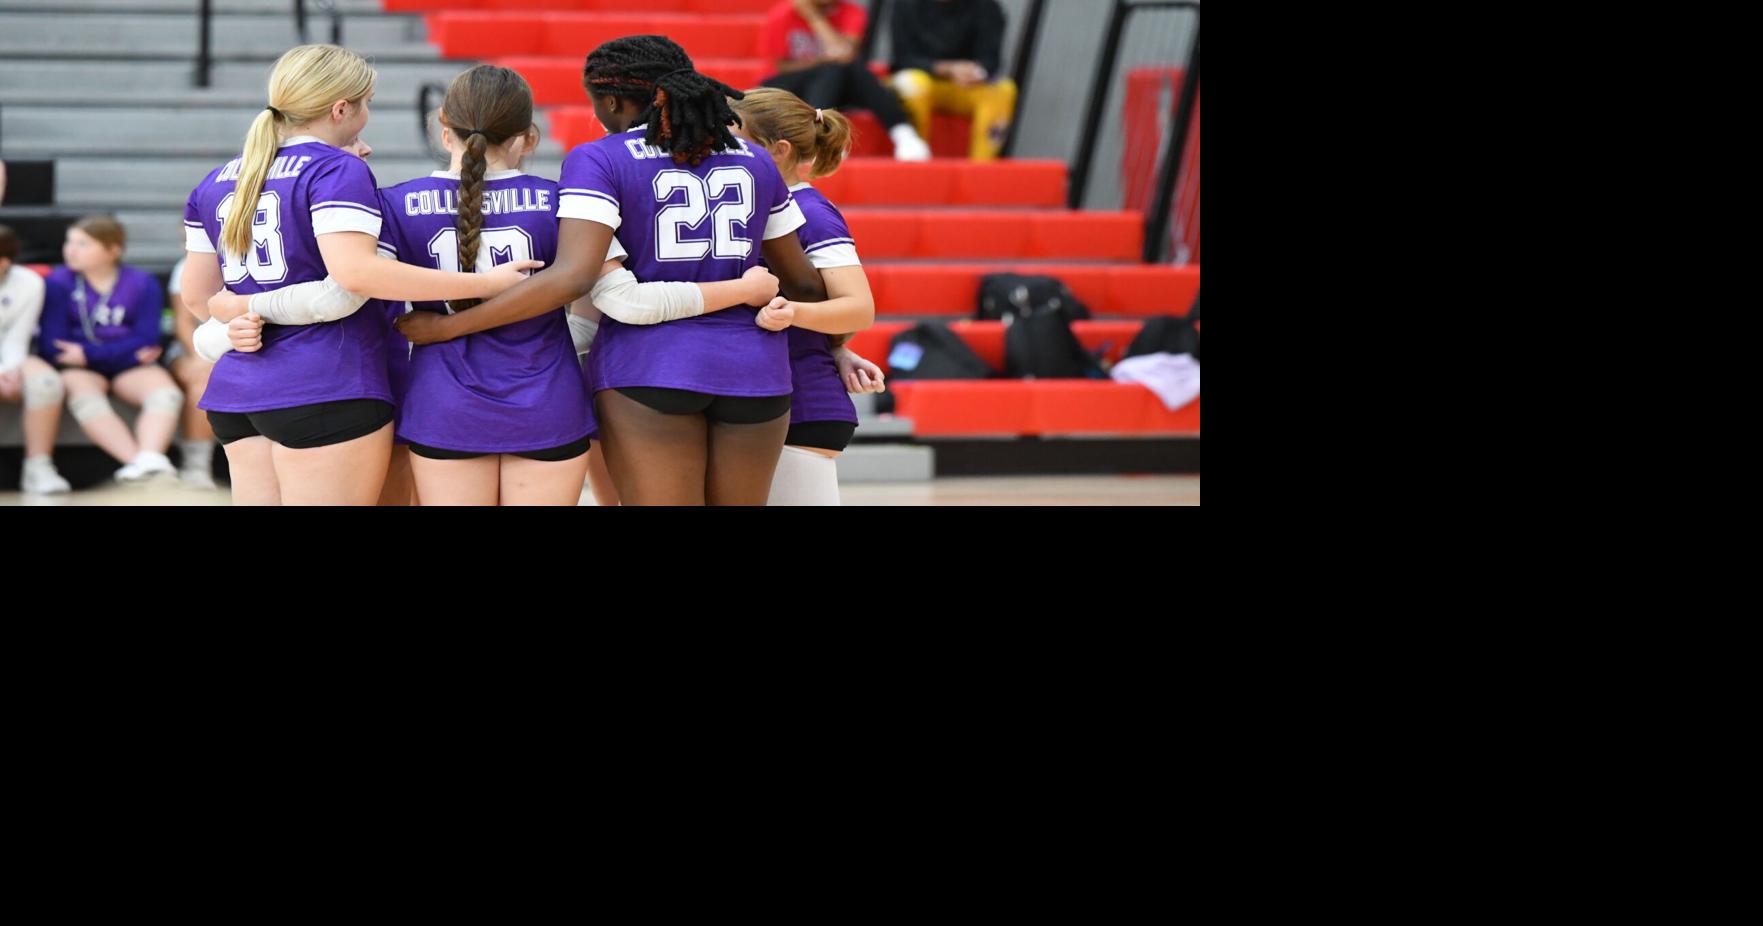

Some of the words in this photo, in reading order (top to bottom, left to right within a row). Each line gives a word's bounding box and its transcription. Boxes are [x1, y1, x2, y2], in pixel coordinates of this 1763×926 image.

[216, 190, 288, 285] 18
[404, 187, 552, 217] COLLSVILLE
[652, 165, 755, 262] 22
